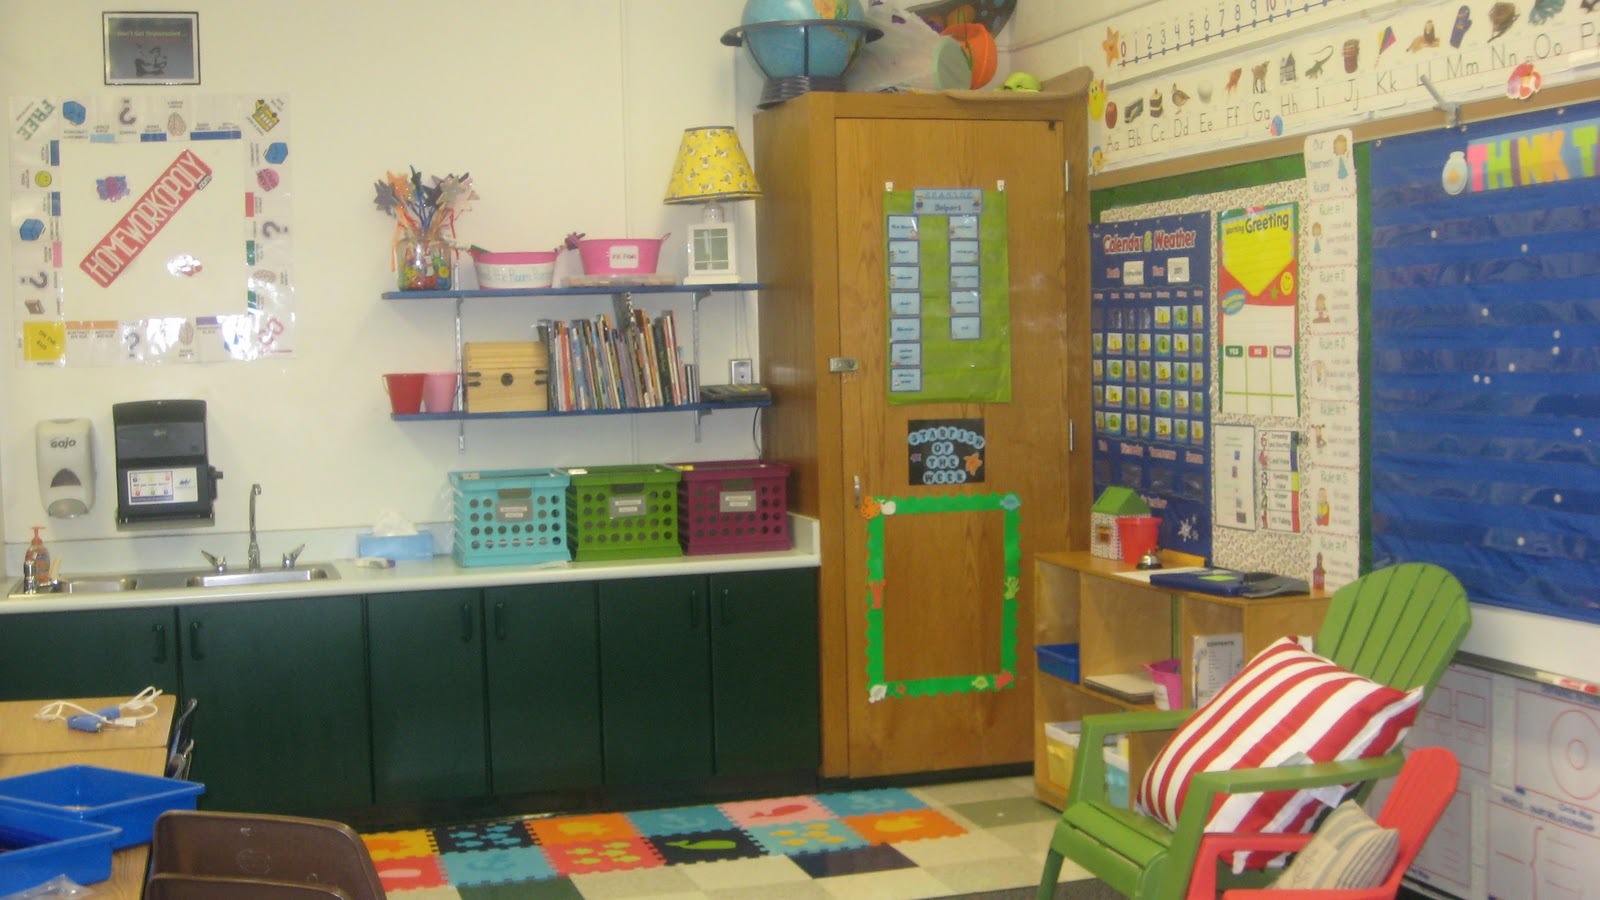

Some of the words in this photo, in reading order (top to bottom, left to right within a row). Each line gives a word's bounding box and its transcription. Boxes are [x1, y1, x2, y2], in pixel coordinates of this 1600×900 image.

[1120, 41, 1127, 58] 0
[1147, 33, 1153, 50] 2
[1160, 28, 1166, 45] 3
[1174, 24, 1180, 40] 4
[1189, 19, 1195, 36] 5
[1203, 14, 1210, 31] 6
[1219, 9, 1225, 26] 7
[1234, 4, 1241, 21] 8
[1106, 134, 1120, 152] Aa
[1128, 127, 1142, 148] Bb
[1151, 123, 1165, 142] Cc
[1174, 116, 1189, 138] Dd
[1200, 112, 1213, 133] Ee
[1227, 106, 1240, 128] Ff
[1280, 92, 1299, 117] Hh
[1344, 78, 1360, 111] Jj
[1376, 70, 1398, 95] Kk
[1446, 53, 1480, 80] Mm
[1491, 44, 1518, 70] Nn
[1534, 33, 1562, 59] Oo
[16, 99, 56, 141] FREE
[1467, 130, 1570, 192] THINK
[1573, 125, 1600, 178] T
[84, 150, 209, 285] HOMEWORKOPOLY
[1245, 213, 1289, 234] Greeting
[1103, 233, 1144, 255] Calendar
[1154, 227, 1197, 251] Weather
[909, 428, 985, 448] STARFISH
[933, 442, 953, 454] OF
[927, 457, 958, 468] THE
[924, 471, 966, 484] WEEK
